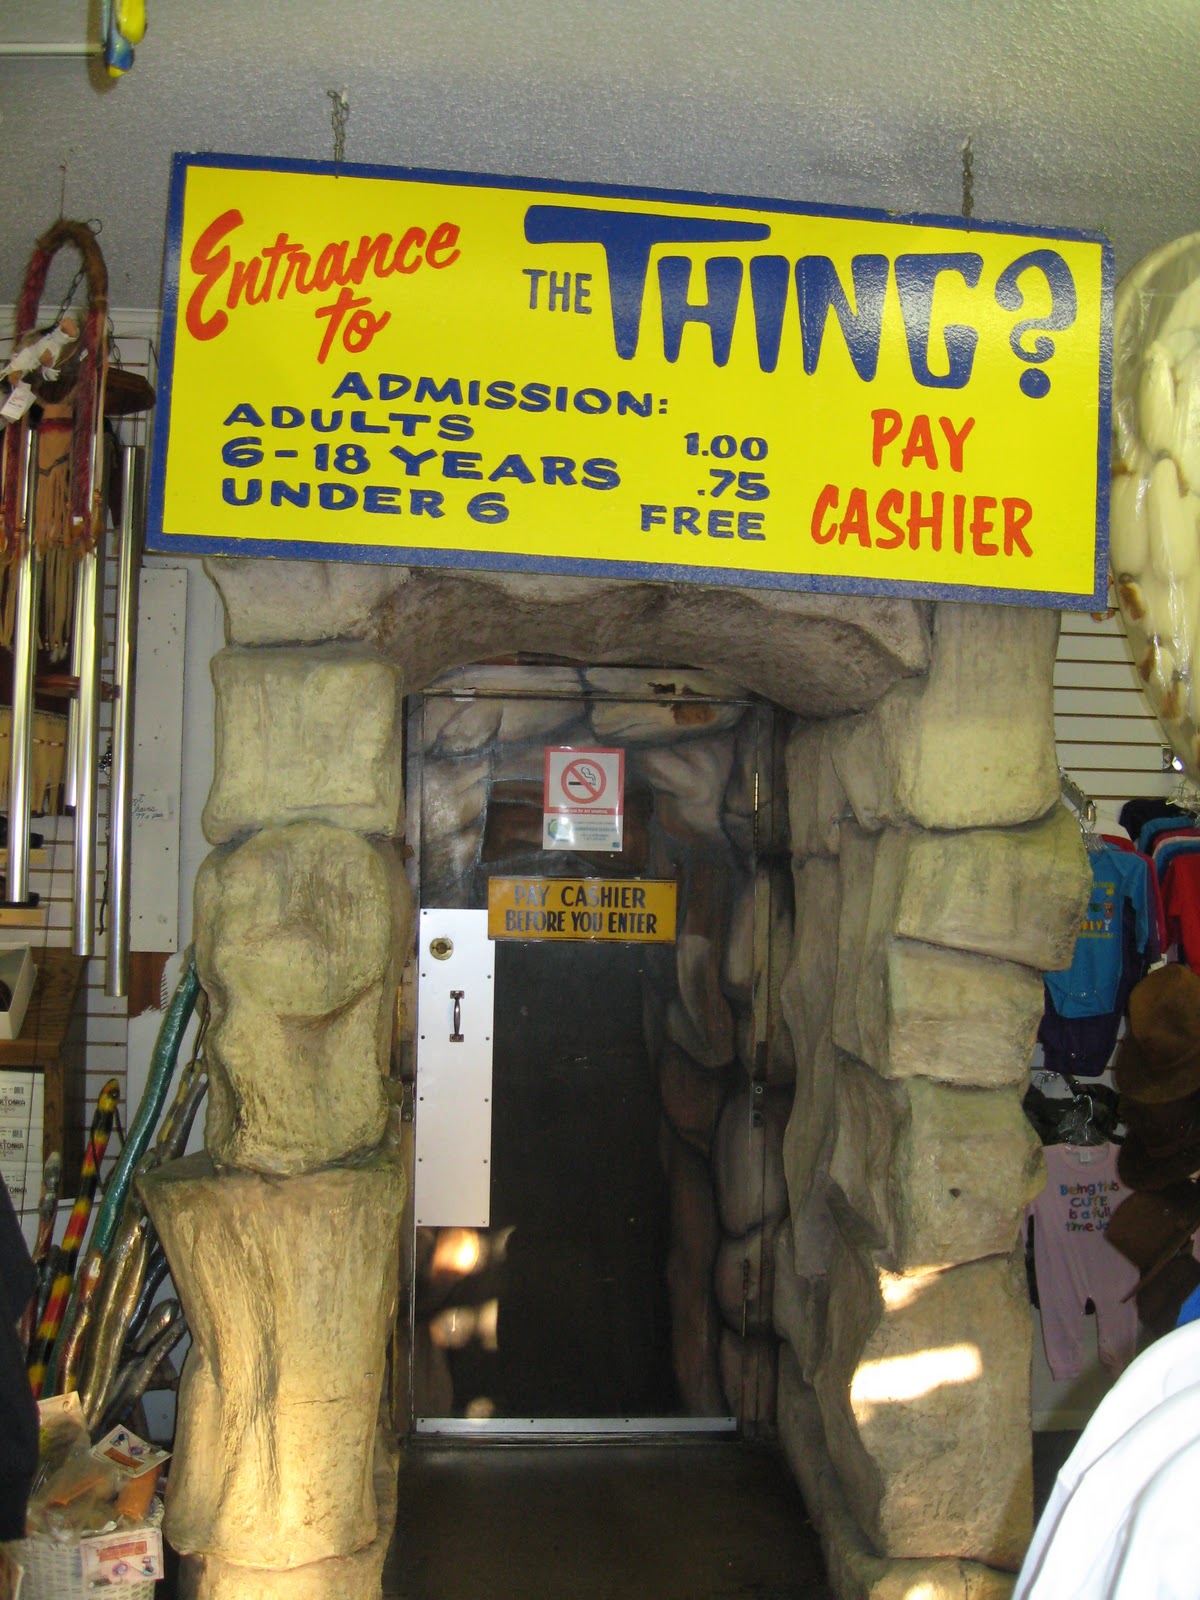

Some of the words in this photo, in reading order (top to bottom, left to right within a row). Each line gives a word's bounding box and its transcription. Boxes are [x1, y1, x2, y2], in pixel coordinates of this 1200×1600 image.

[186, 209, 461, 341] Entrance
[522, 268, 593, 315] THE
[523, 204, 1078, 399] THING?
[315, 287, 391, 364] to
[332, 372, 668, 418] ADMISSION:
[223, 403, 475, 442] ADULTS
[870, 408, 976, 473] PAY
[389, 445, 622, 491] YEARS
[684, 432, 769, 461] 1.00
[222, 477, 446, 520] UNDER
[466, 493, 510, 525] 6
[698, 469, 771, 501] .75
[640, 504, 767, 541] FREE
[810, 484, 1034, 558] CASHIER
[514, 885, 549, 907] PAY
[561, 885, 646, 909] CASHIER
[505, 909, 565, 933] BEFORE
[571, 911, 603, 933] YOU
[608, 911, 657, 934] ENTER
[1060, 1183, 1096, 1196] Being
